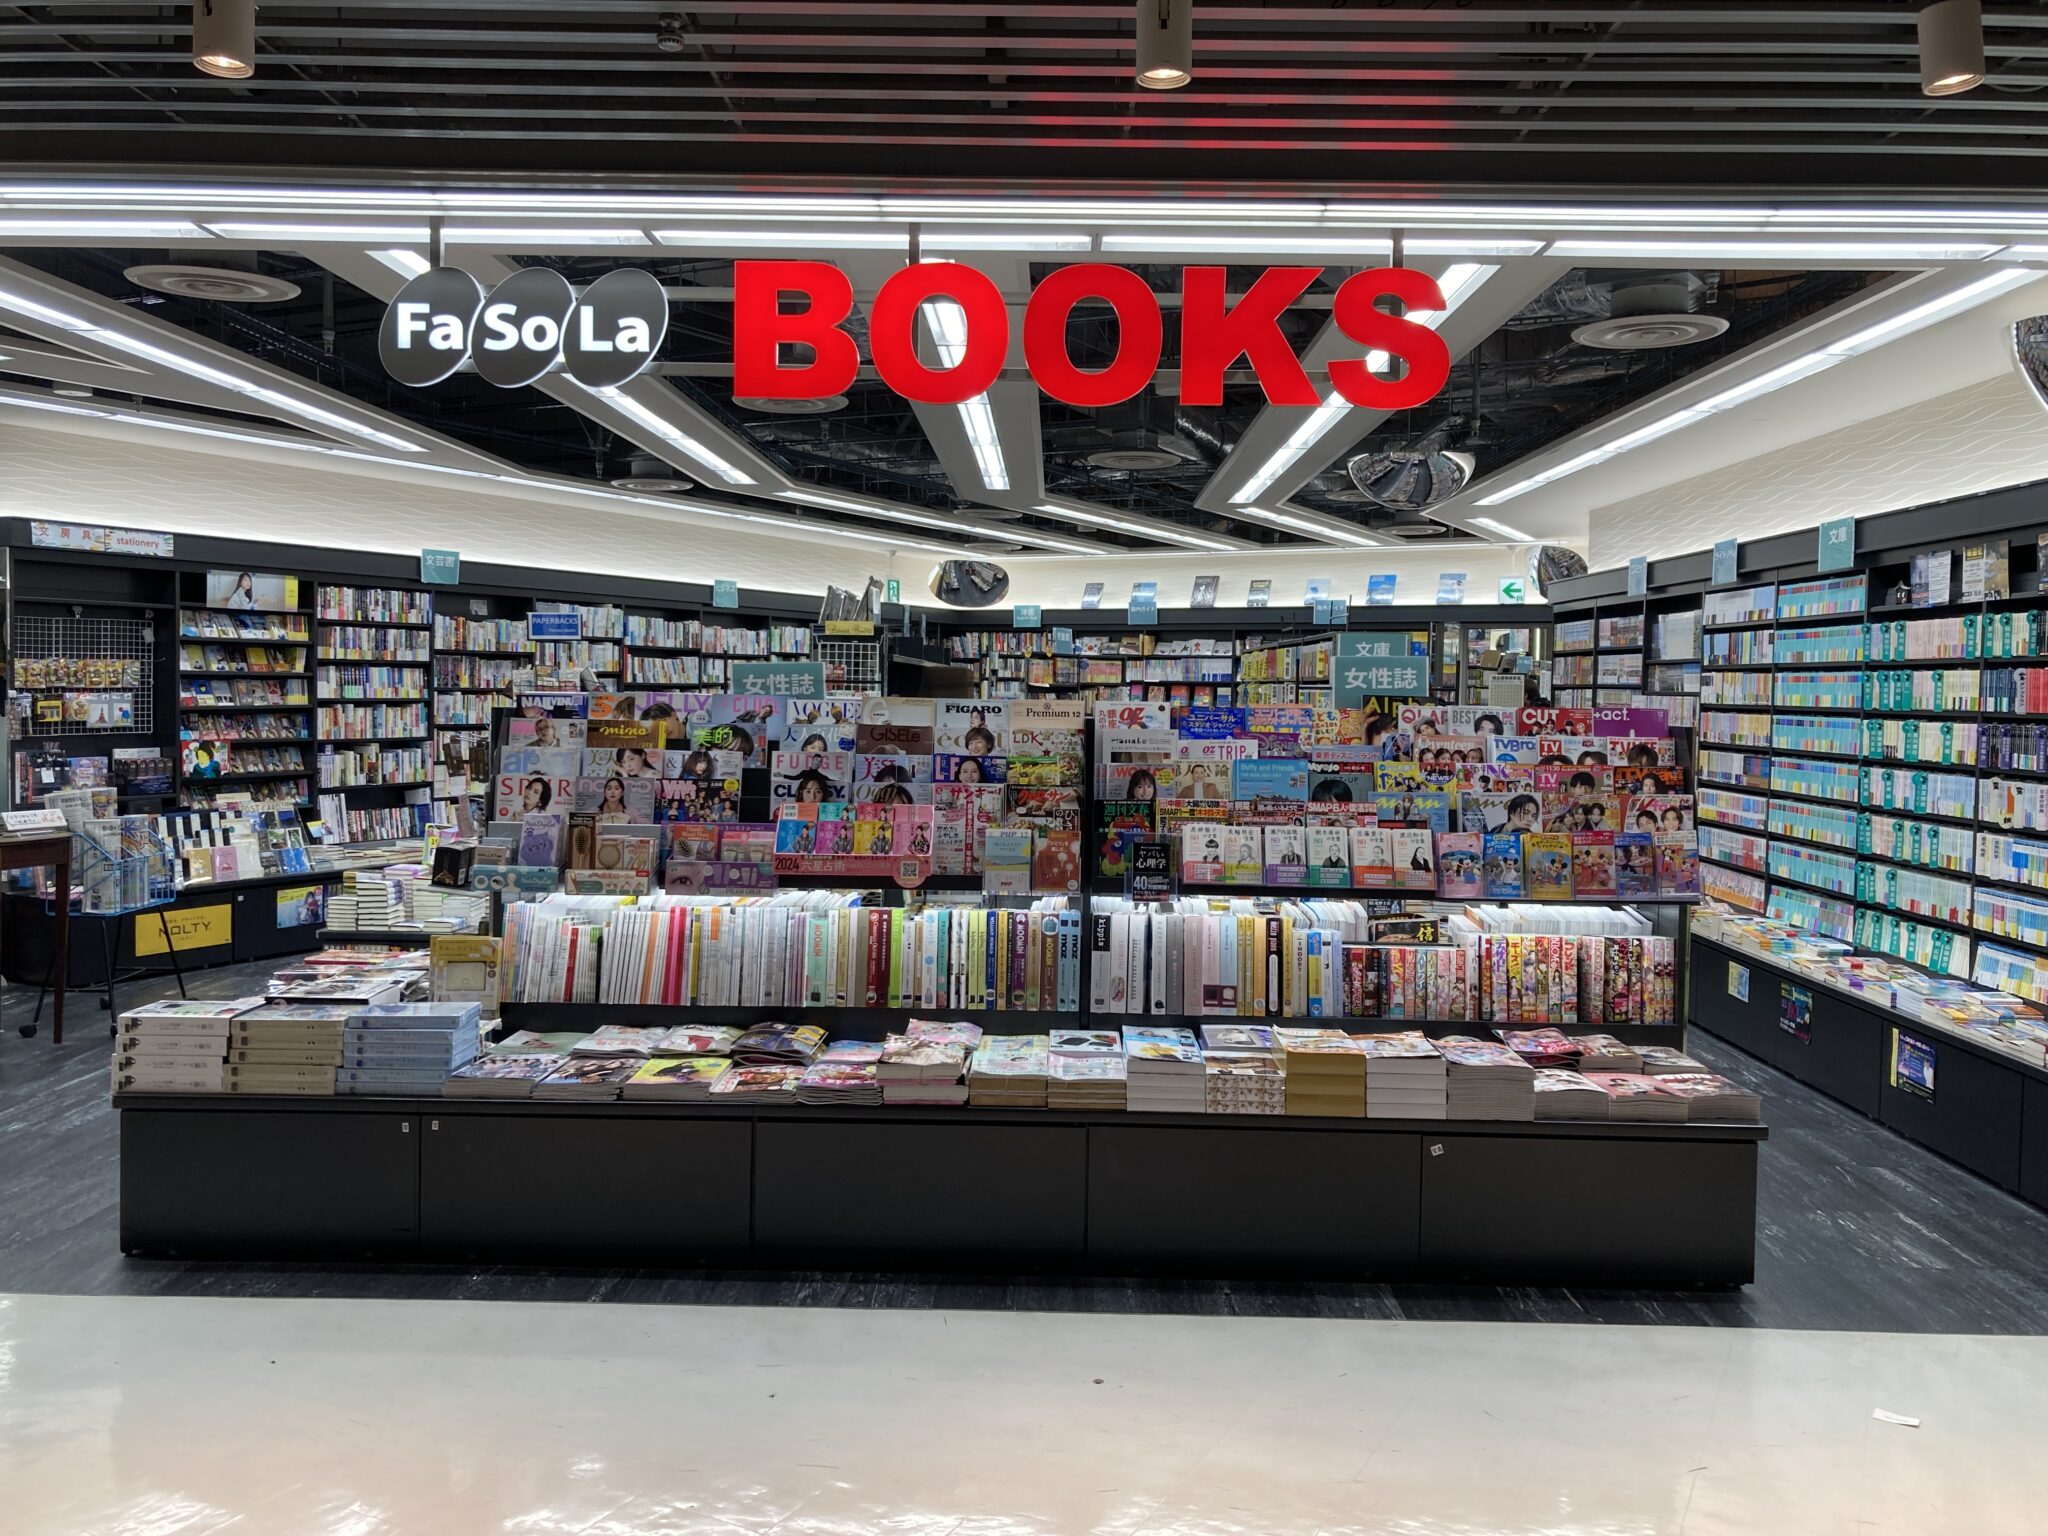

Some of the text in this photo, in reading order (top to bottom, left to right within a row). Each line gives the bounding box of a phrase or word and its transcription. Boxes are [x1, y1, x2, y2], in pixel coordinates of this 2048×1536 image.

[733, 260, 1452, 410] BOOKS
[40, 527, 92, 541] 文房具
[1828, 527, 1847, 544] 文庫
[116, 536, 160, 550] stationery
[425, 555, 455, 568] 文芸書
[532, 616, 578, 625] PAPERBACKS
[1355, 641, 1391, 656] 文庫
[742, 673, 815, 695] 女性誌
[1344, 667, 1418, 690] 女性誌
[945, 705, 1002, 714] FIGARO
[1026, 707, 1070, 718] Premium
[1452, 709, 1477, 724] BEST
[1522, 708, 1560, 725] CUT
[1188, 713, 1237, 722] ユニバーサル
[693, 727, 733, 747] 美的
[1218, 745, 1247, 760] TRIP
[1541, 741, 1561, 751] TV
[776, 753, 845, 771] FUDGE
[1541, 773, 1558, 783] TV
[500, 776, 574, 797] SPR
[773, 783, 846, 799] CLSY.
[775, 857, 799, 870] 2024
[1136, 858, 1167, 869] 心理学
[1133, 875, 1148, 891] 40
[158, 921, 212, 938] NOLTY
[1416, 926, 1435, 942] 信
